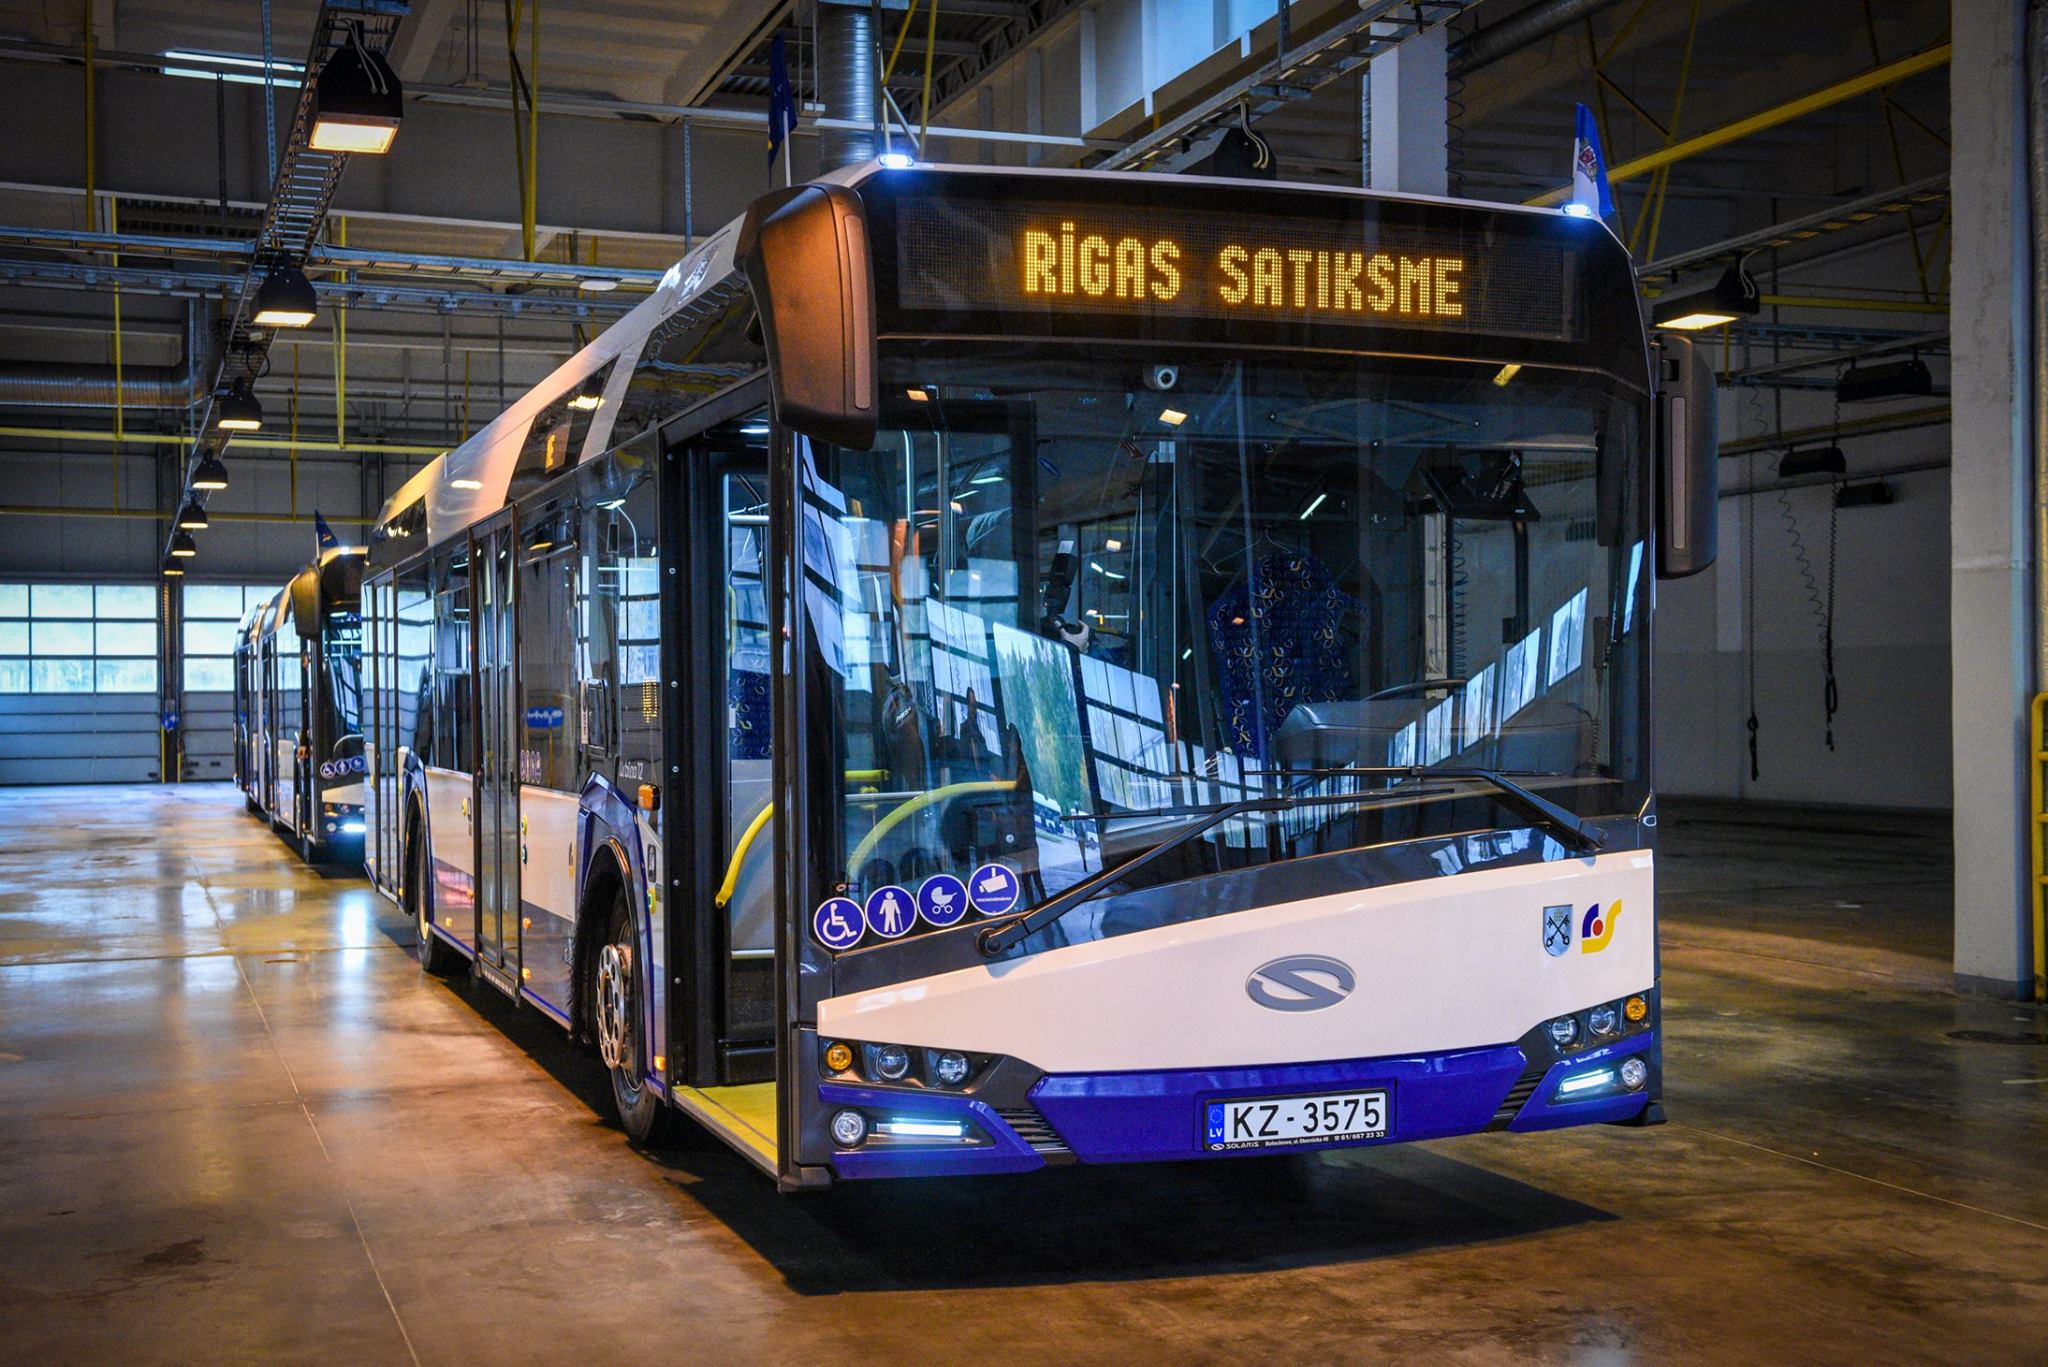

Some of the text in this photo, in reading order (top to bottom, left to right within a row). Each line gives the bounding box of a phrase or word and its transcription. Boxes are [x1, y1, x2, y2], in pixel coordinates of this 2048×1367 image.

[1218, 244, 1464, 317] SATIKSME
[1209, 1127, 1223, 1138] LV
[1225, 1141, 1259, 1149] SOLARIS
